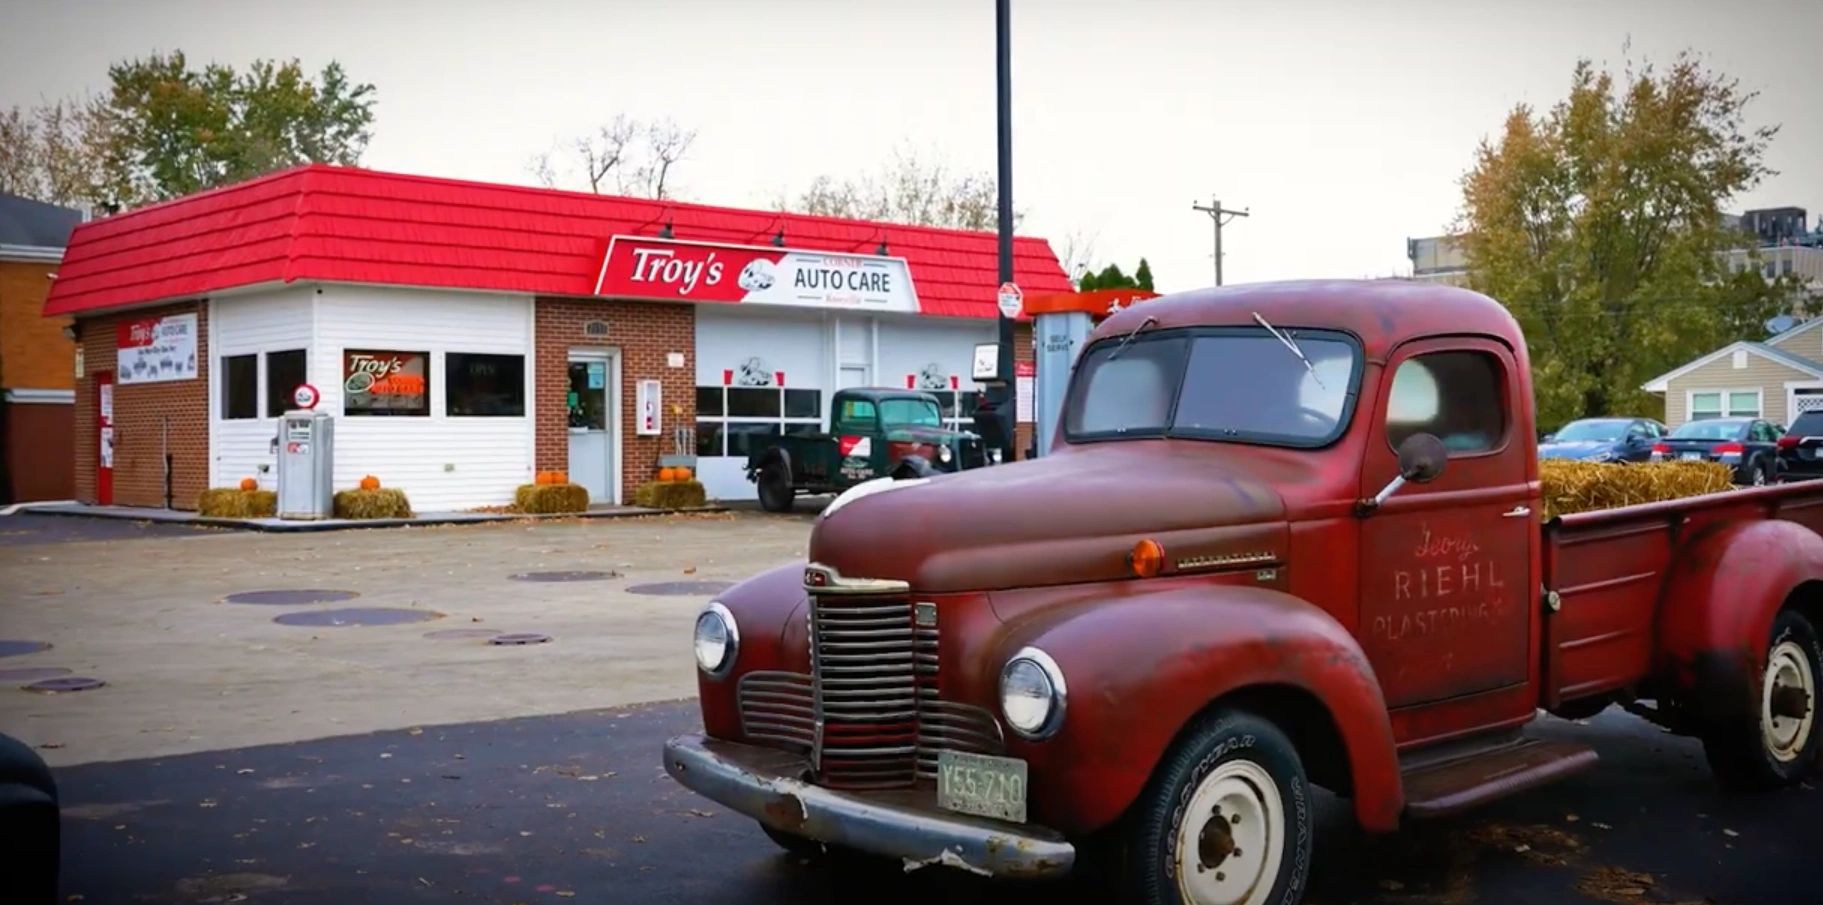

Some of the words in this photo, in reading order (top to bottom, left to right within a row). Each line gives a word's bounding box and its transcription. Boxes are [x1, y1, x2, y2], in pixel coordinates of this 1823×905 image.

[631, 248, 723, 294] Troy's
[795, 268, 843, 289] AUTO
[848, 271, 890, 292] CARE
[350, 354, 402, 378] Troy's
[1394, 560, 1504, 600] RIEHL
